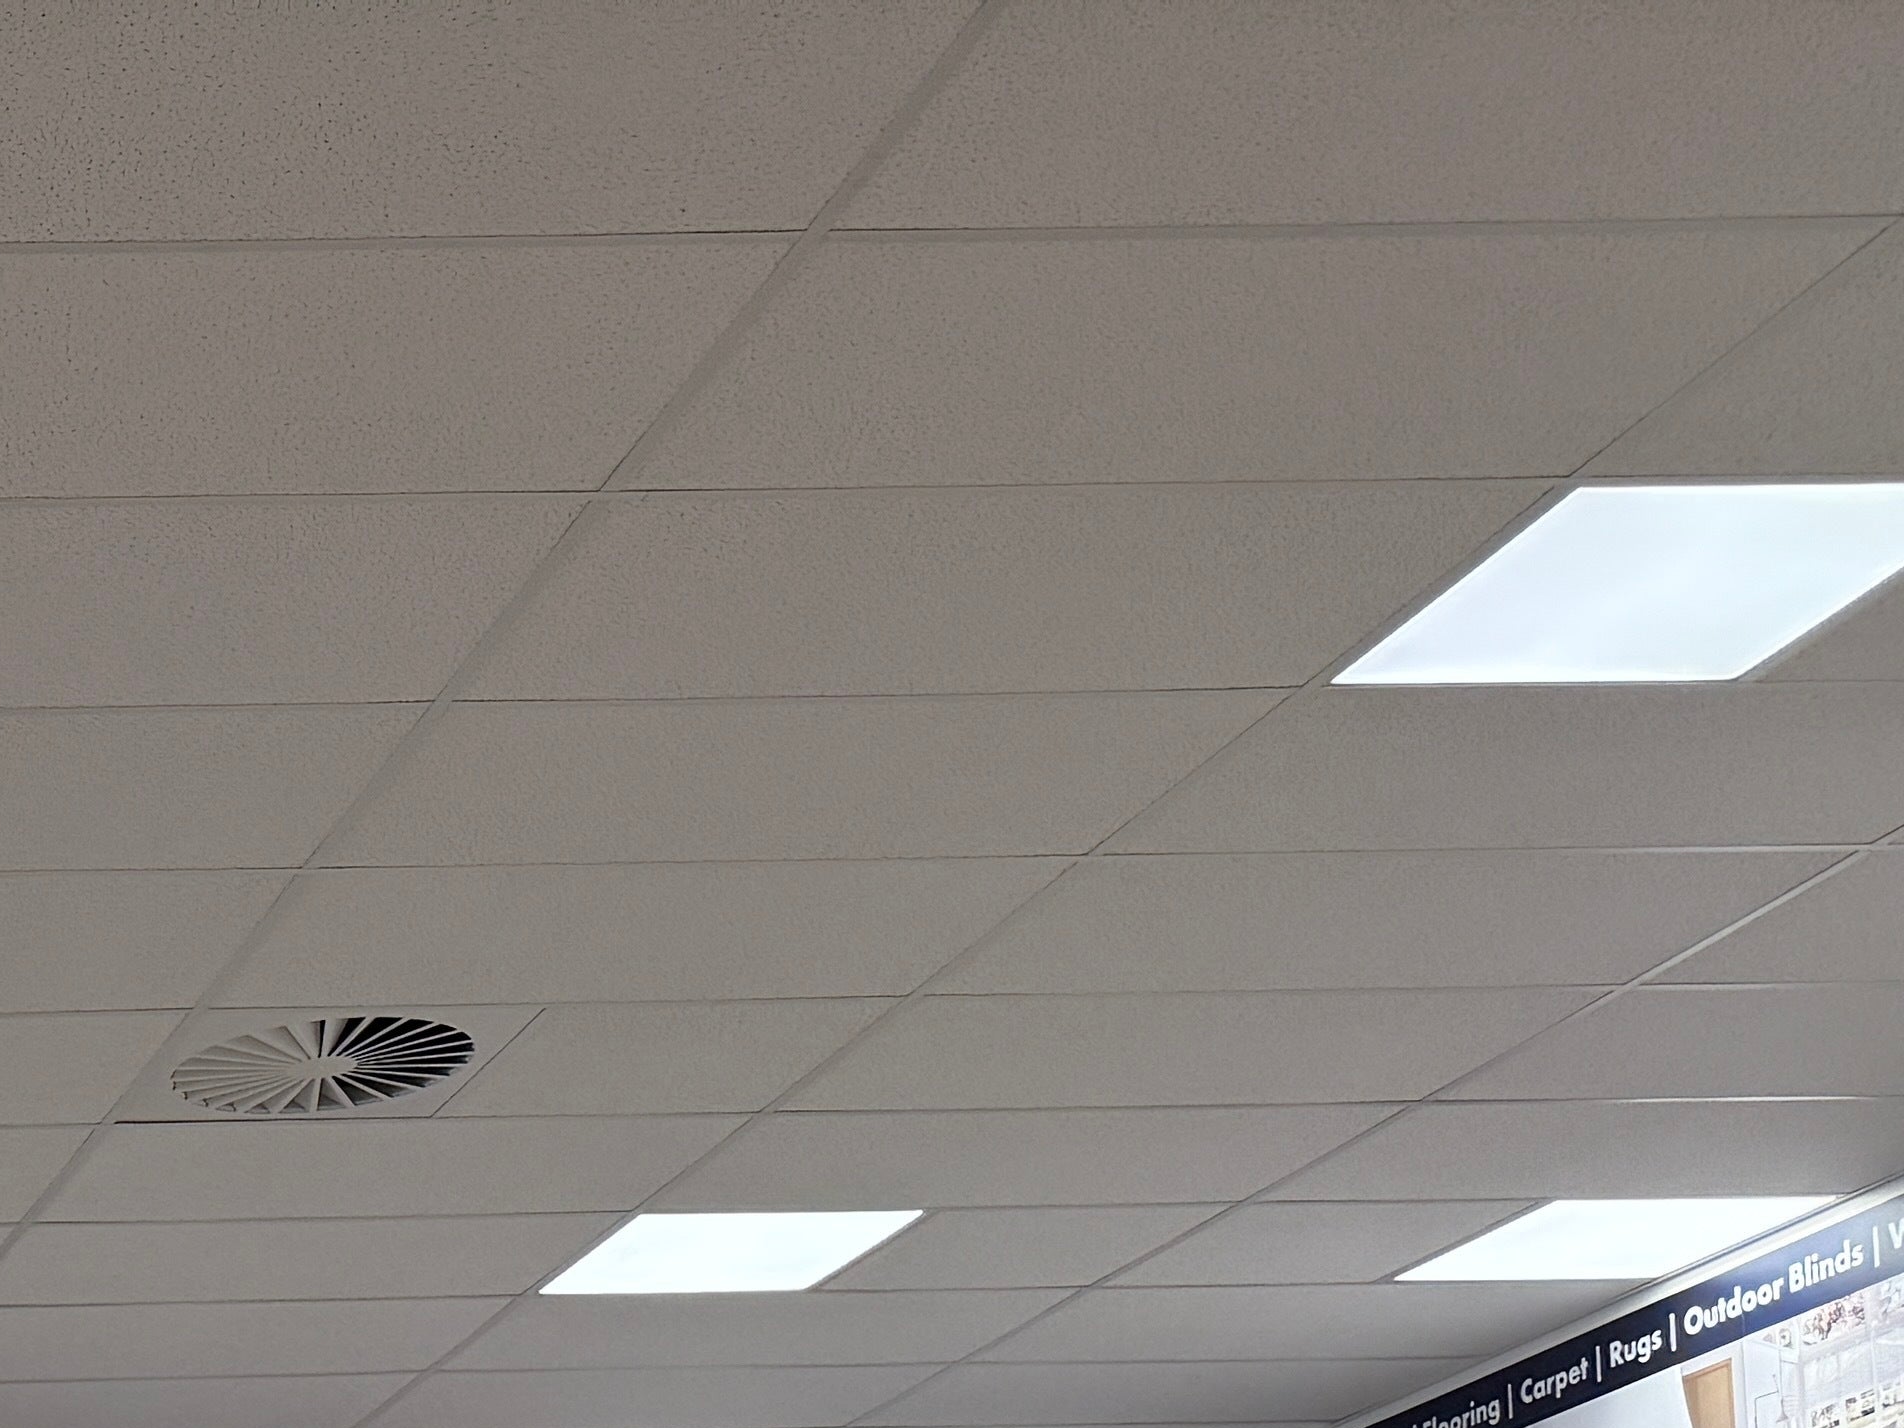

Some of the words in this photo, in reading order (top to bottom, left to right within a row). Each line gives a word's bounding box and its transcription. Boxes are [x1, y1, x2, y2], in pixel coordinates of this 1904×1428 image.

[1520, 1360, 1589, 1404] Carpet
[1609, 1330, 1663, 1369] Rugs
[1683, 1277, 1784, 1335] Outdoor
[1788, 1240, 1864, 1293] Blinds
